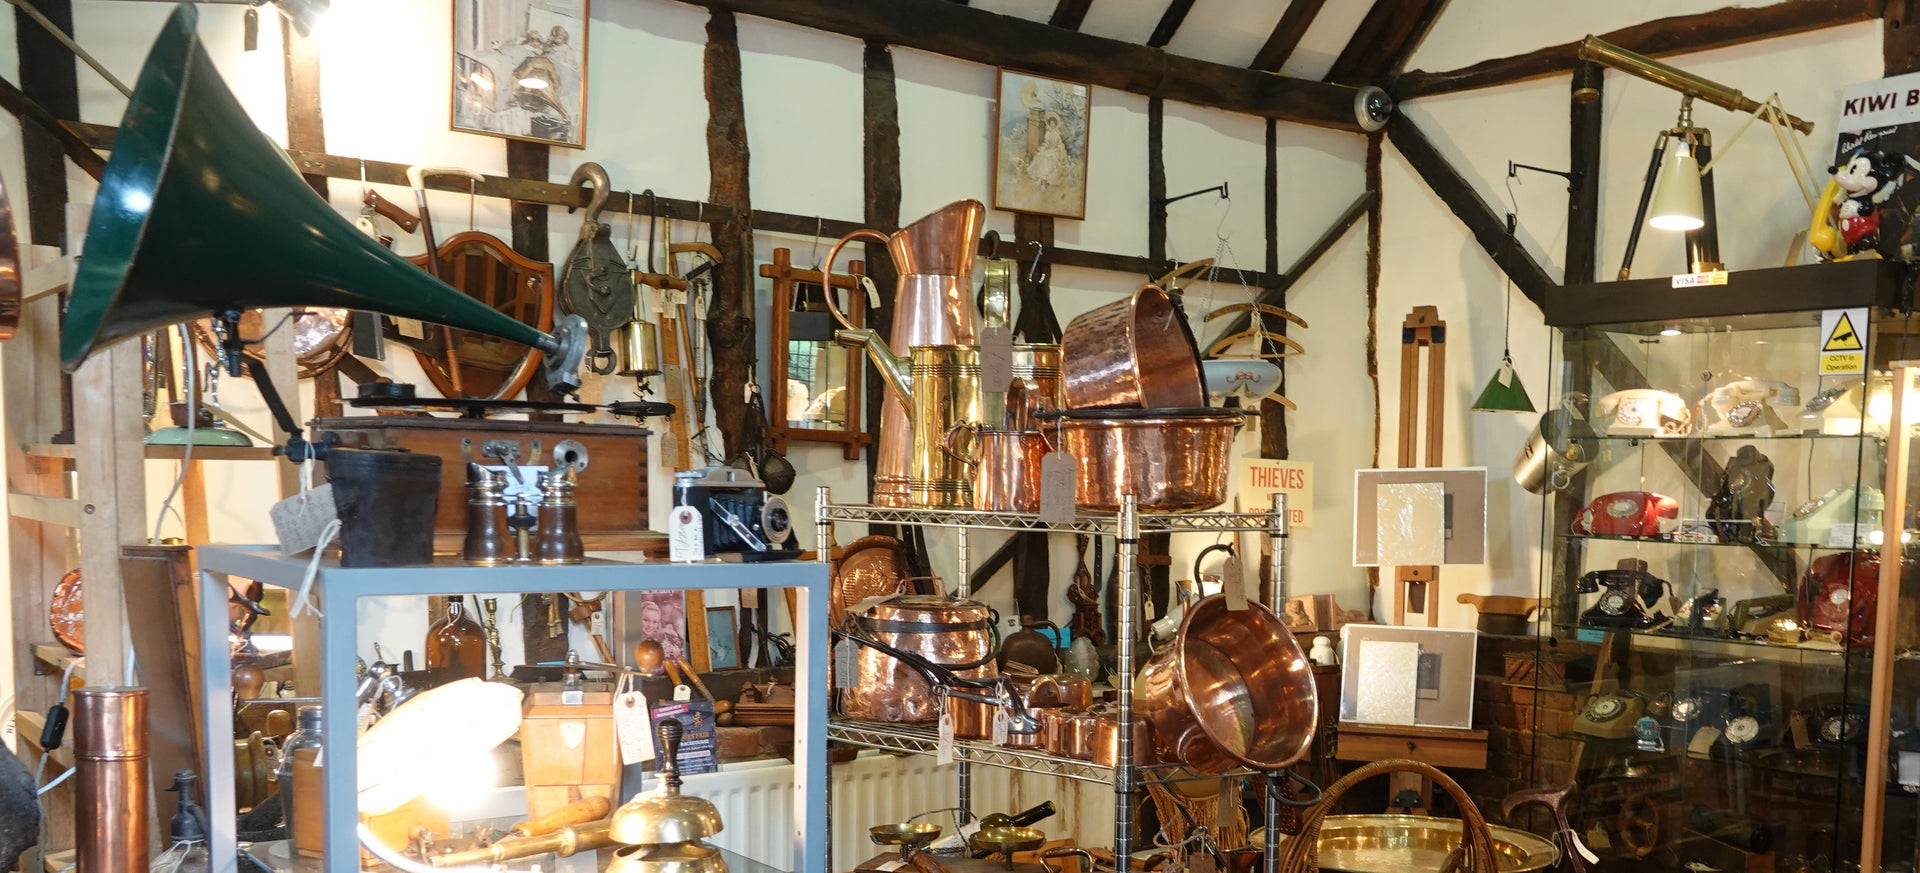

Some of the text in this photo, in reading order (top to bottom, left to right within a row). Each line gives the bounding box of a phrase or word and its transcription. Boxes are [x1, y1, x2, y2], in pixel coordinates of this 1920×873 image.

[1843, 89, 1920, 117] KIWI B
[1675, 276, 1695, 285] VISA
[1829, 354, 1848, 362] CCTV
[1826, 364, 1857, 372] Operation
[1250, 466, 1304, 490] THIEVES
